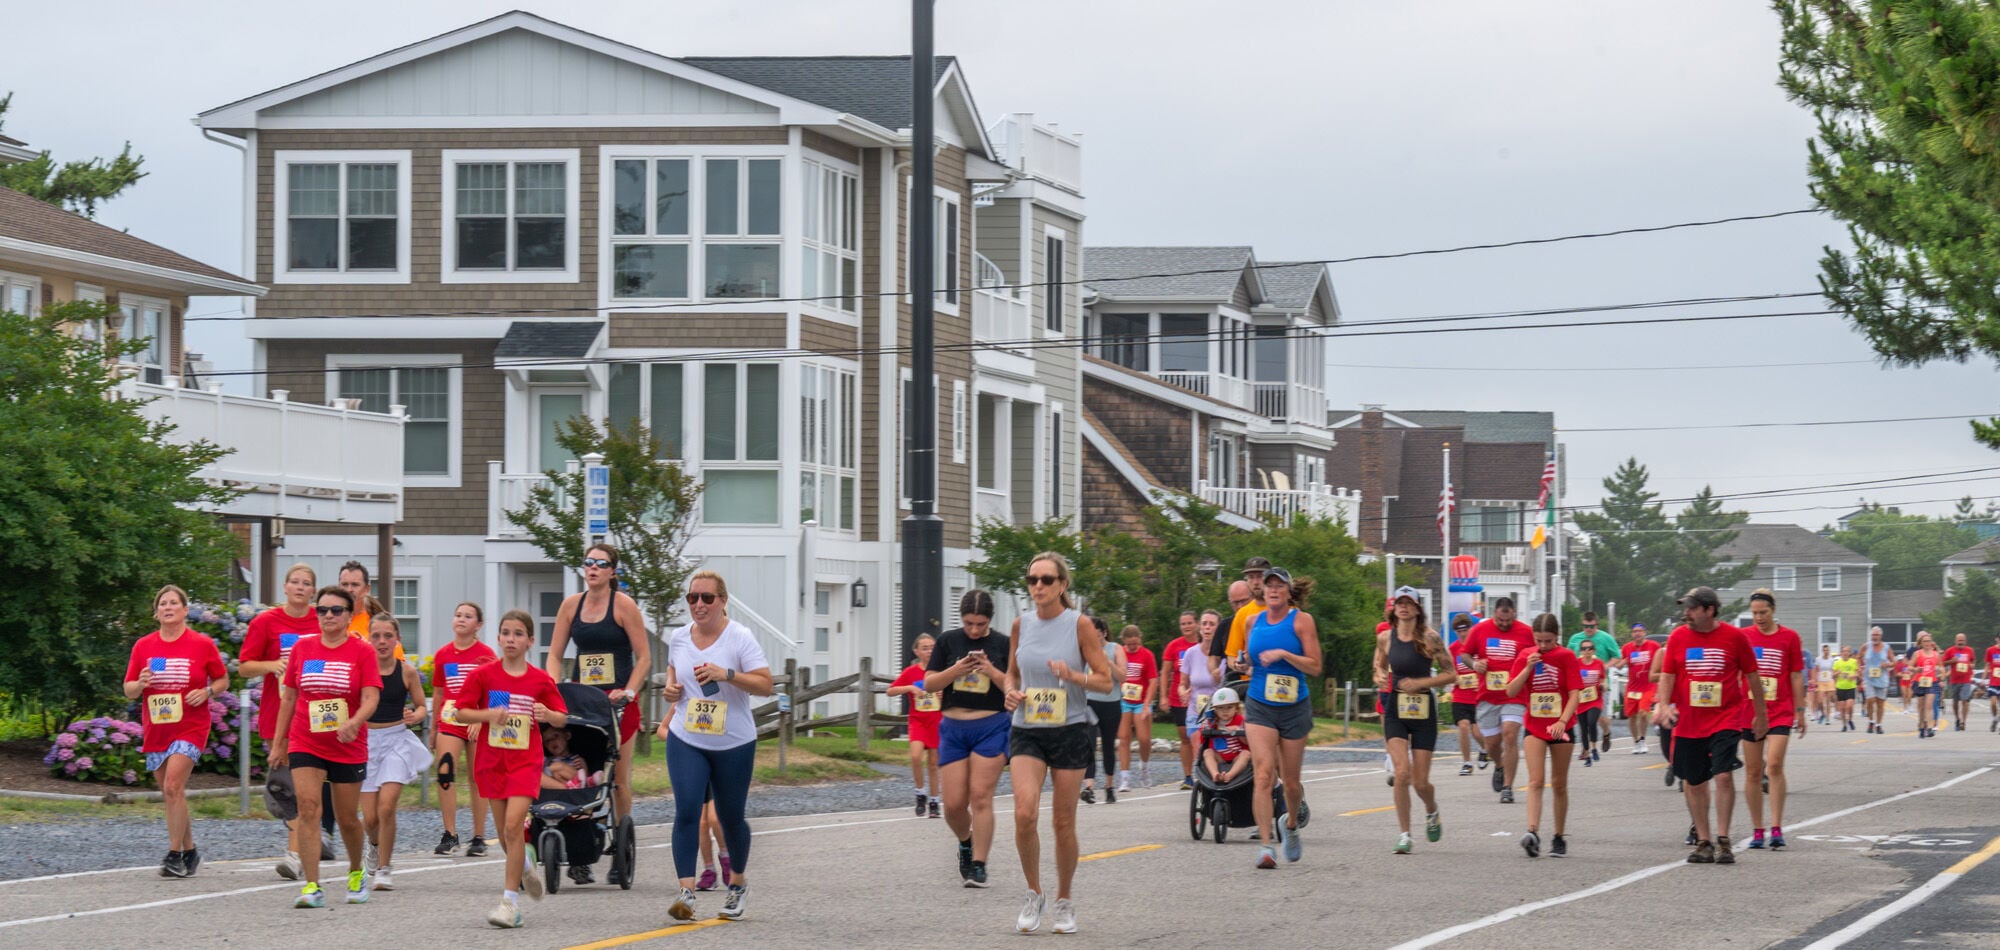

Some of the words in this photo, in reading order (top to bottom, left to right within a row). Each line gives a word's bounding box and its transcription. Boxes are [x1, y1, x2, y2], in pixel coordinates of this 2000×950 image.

[586, 657, 605, 667] 292
[1274, 677, 1292, 687] 438
[152, 696, 177, 707] 1065
[1034, 692, 1056, 703] 439
[1538, 695, 1555, 703] 899
[318, 702, 339, 713] 355
[695, 702, 717, 714] 337
[506, 718, 522, 728] 40
